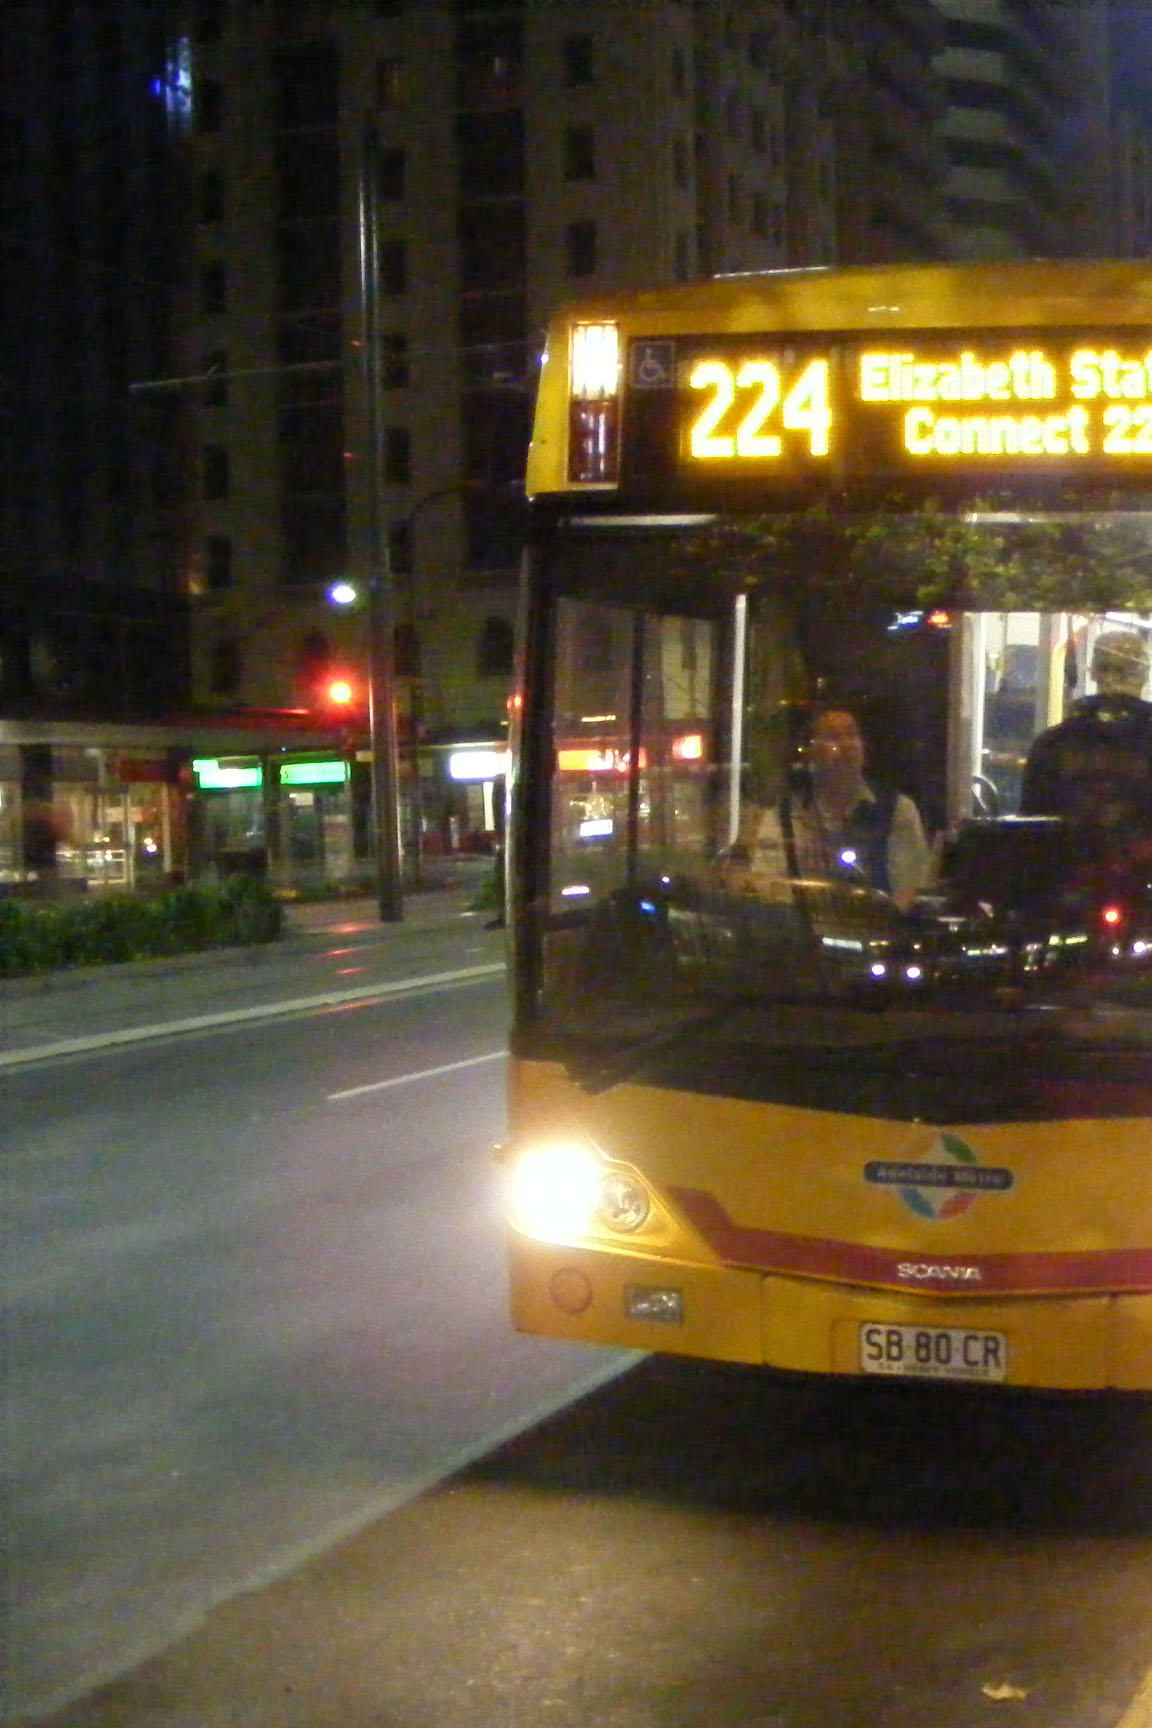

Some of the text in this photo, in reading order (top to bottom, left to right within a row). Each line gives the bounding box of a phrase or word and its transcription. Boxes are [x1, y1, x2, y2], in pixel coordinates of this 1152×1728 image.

[689, 358, 833, 460] 224
[859, 349, 1056, 402] Elizabeth
[903, 407, 1089, 456] Connect
[896, 1262, 983, 1281] SCANIA
